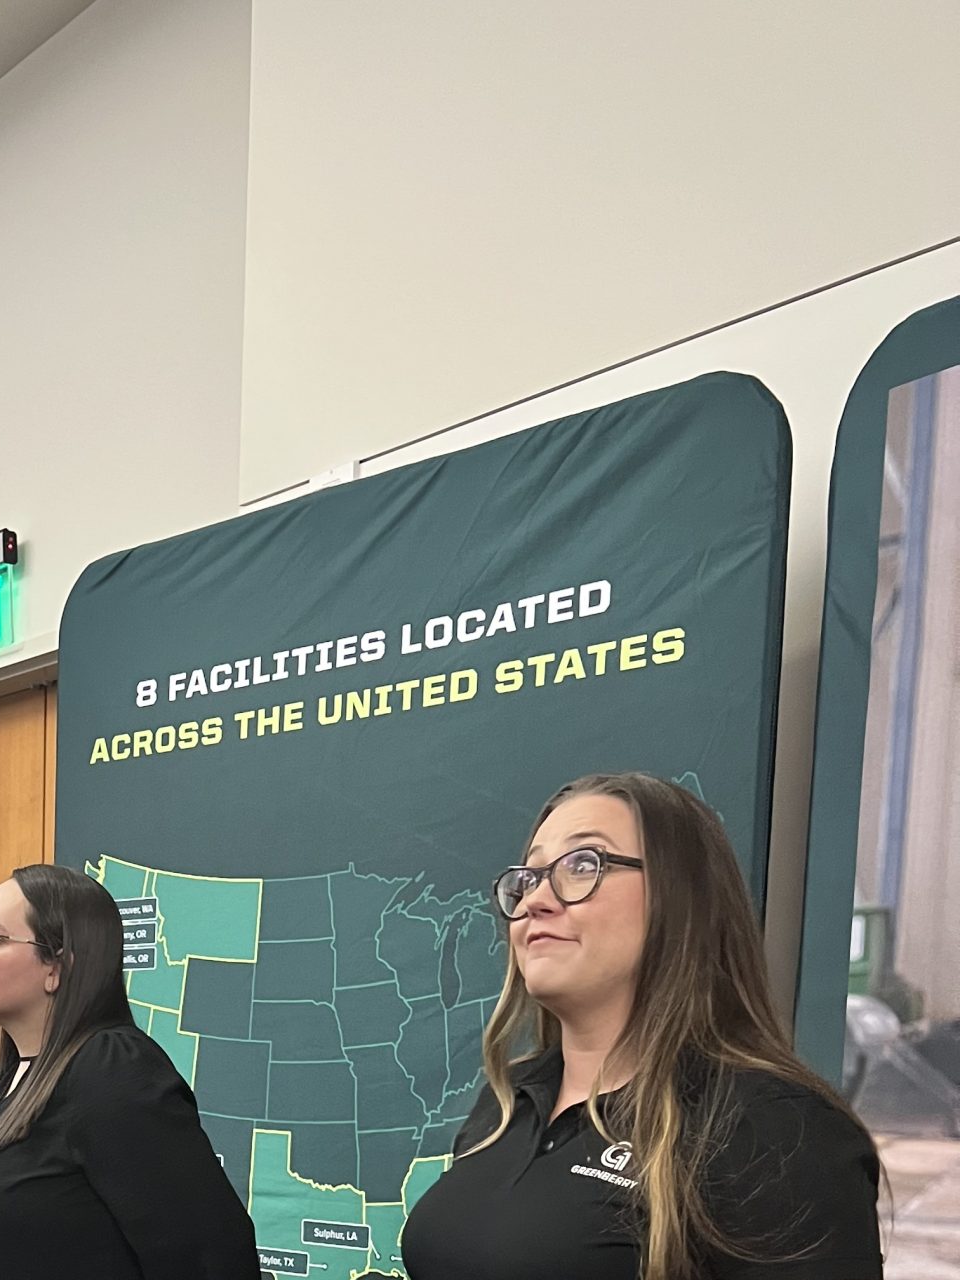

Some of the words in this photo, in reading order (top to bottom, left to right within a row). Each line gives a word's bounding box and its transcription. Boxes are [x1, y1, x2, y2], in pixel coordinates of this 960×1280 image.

[135, 679, 158, 708] 8
[167, 629, 386, 702] FACILITIES
[401, 579, 612, 656] LOCATED
[89, 716, 222, 765] ACROSS
[234, 701, 304, 740] THE
[317, 668, 478, 725] UNITED
[495, 627, 686, 694] STATES
[570, 1164, 639, 1189] GREENBERRY
[313, 1227, 345, 1241] Sulphur,
[347, 1231, 358, 1241] LA
[284, 1257, 294, 1267] TX
